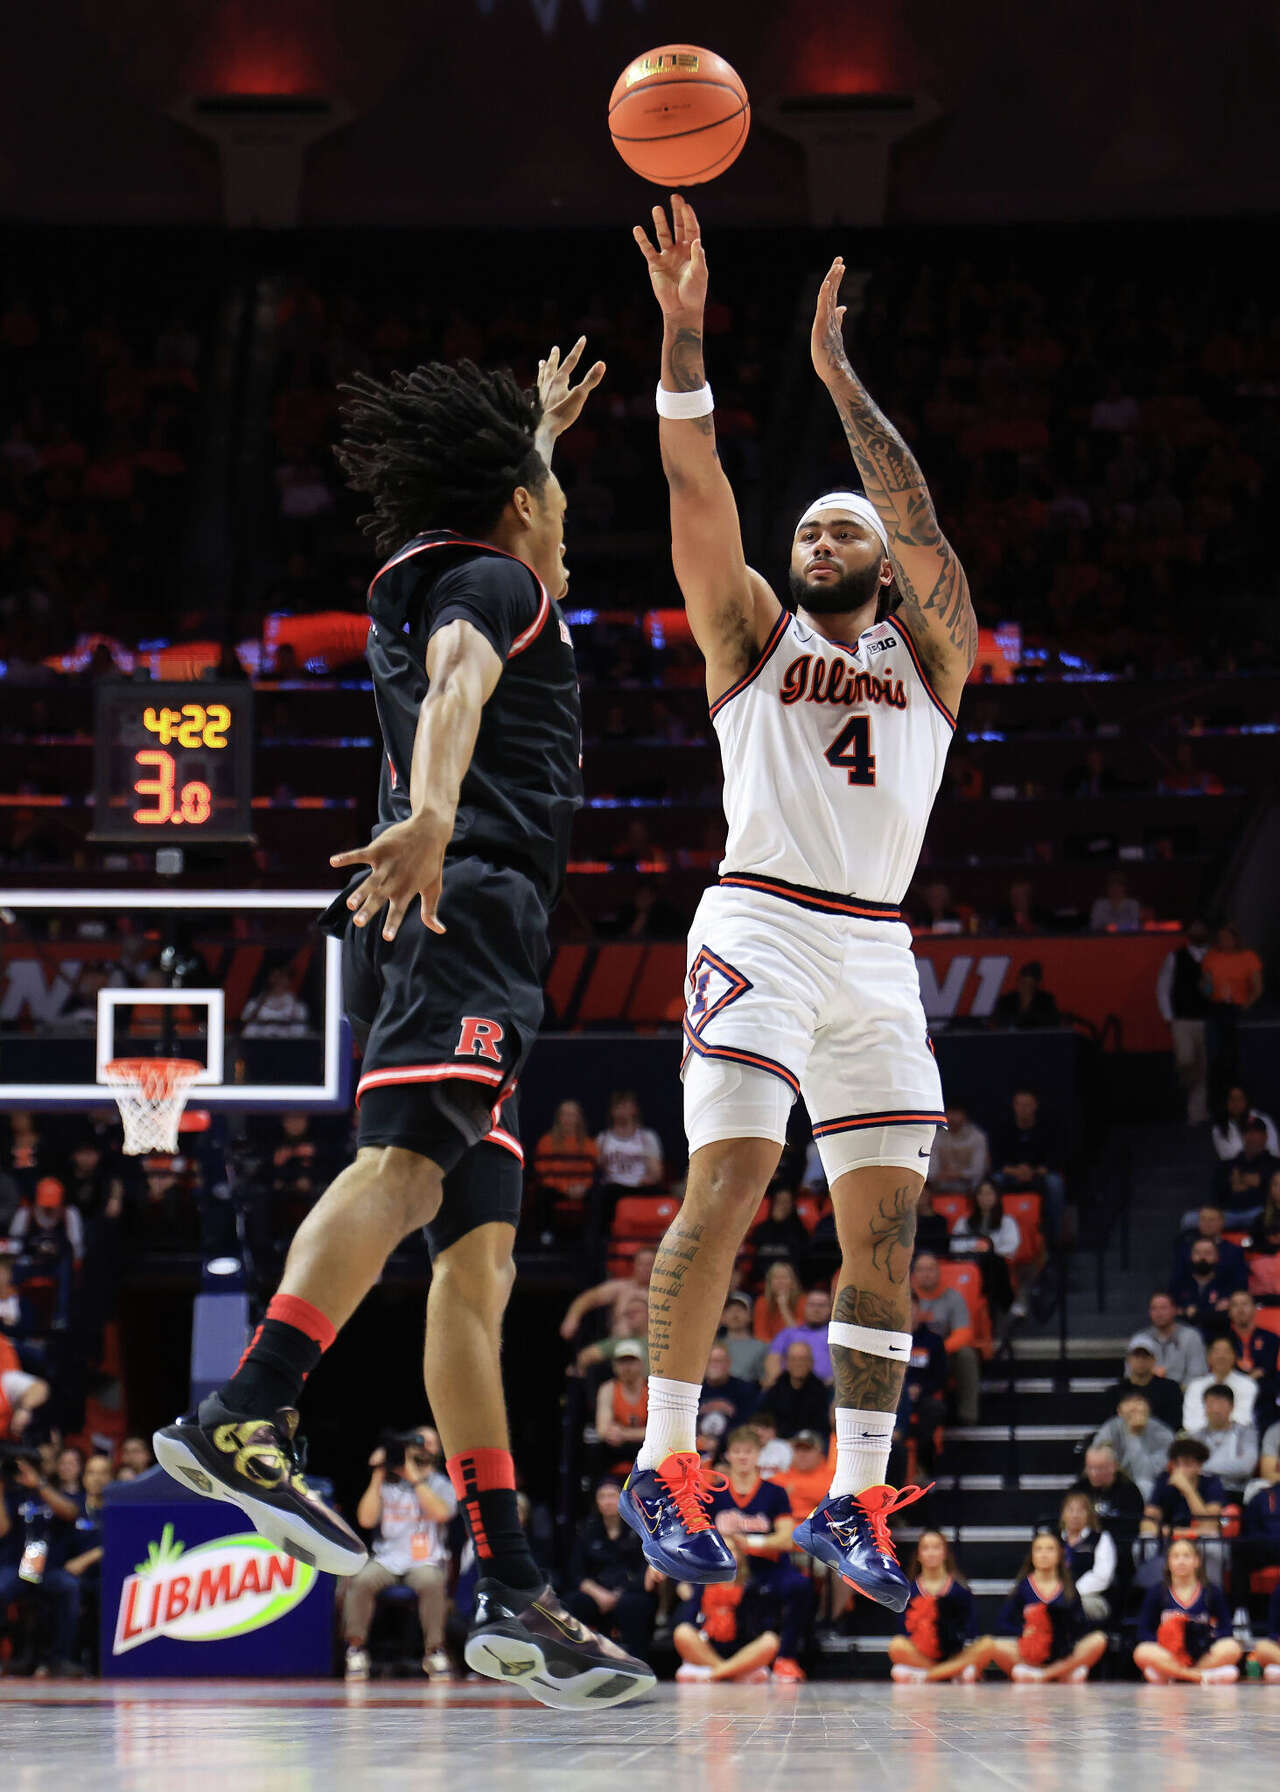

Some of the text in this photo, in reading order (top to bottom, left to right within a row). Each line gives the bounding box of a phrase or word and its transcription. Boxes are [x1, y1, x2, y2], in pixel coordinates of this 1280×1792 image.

[625, 53, 699, 88] ELIT
[779, 654, 907, 711] Illinois
[143, 704, 231, 748] 4:22
[824, 715, 876, 787] 4
[454, 1016, 504, 1063] R
[122, 1555, 295, 1642] LIBMAN
